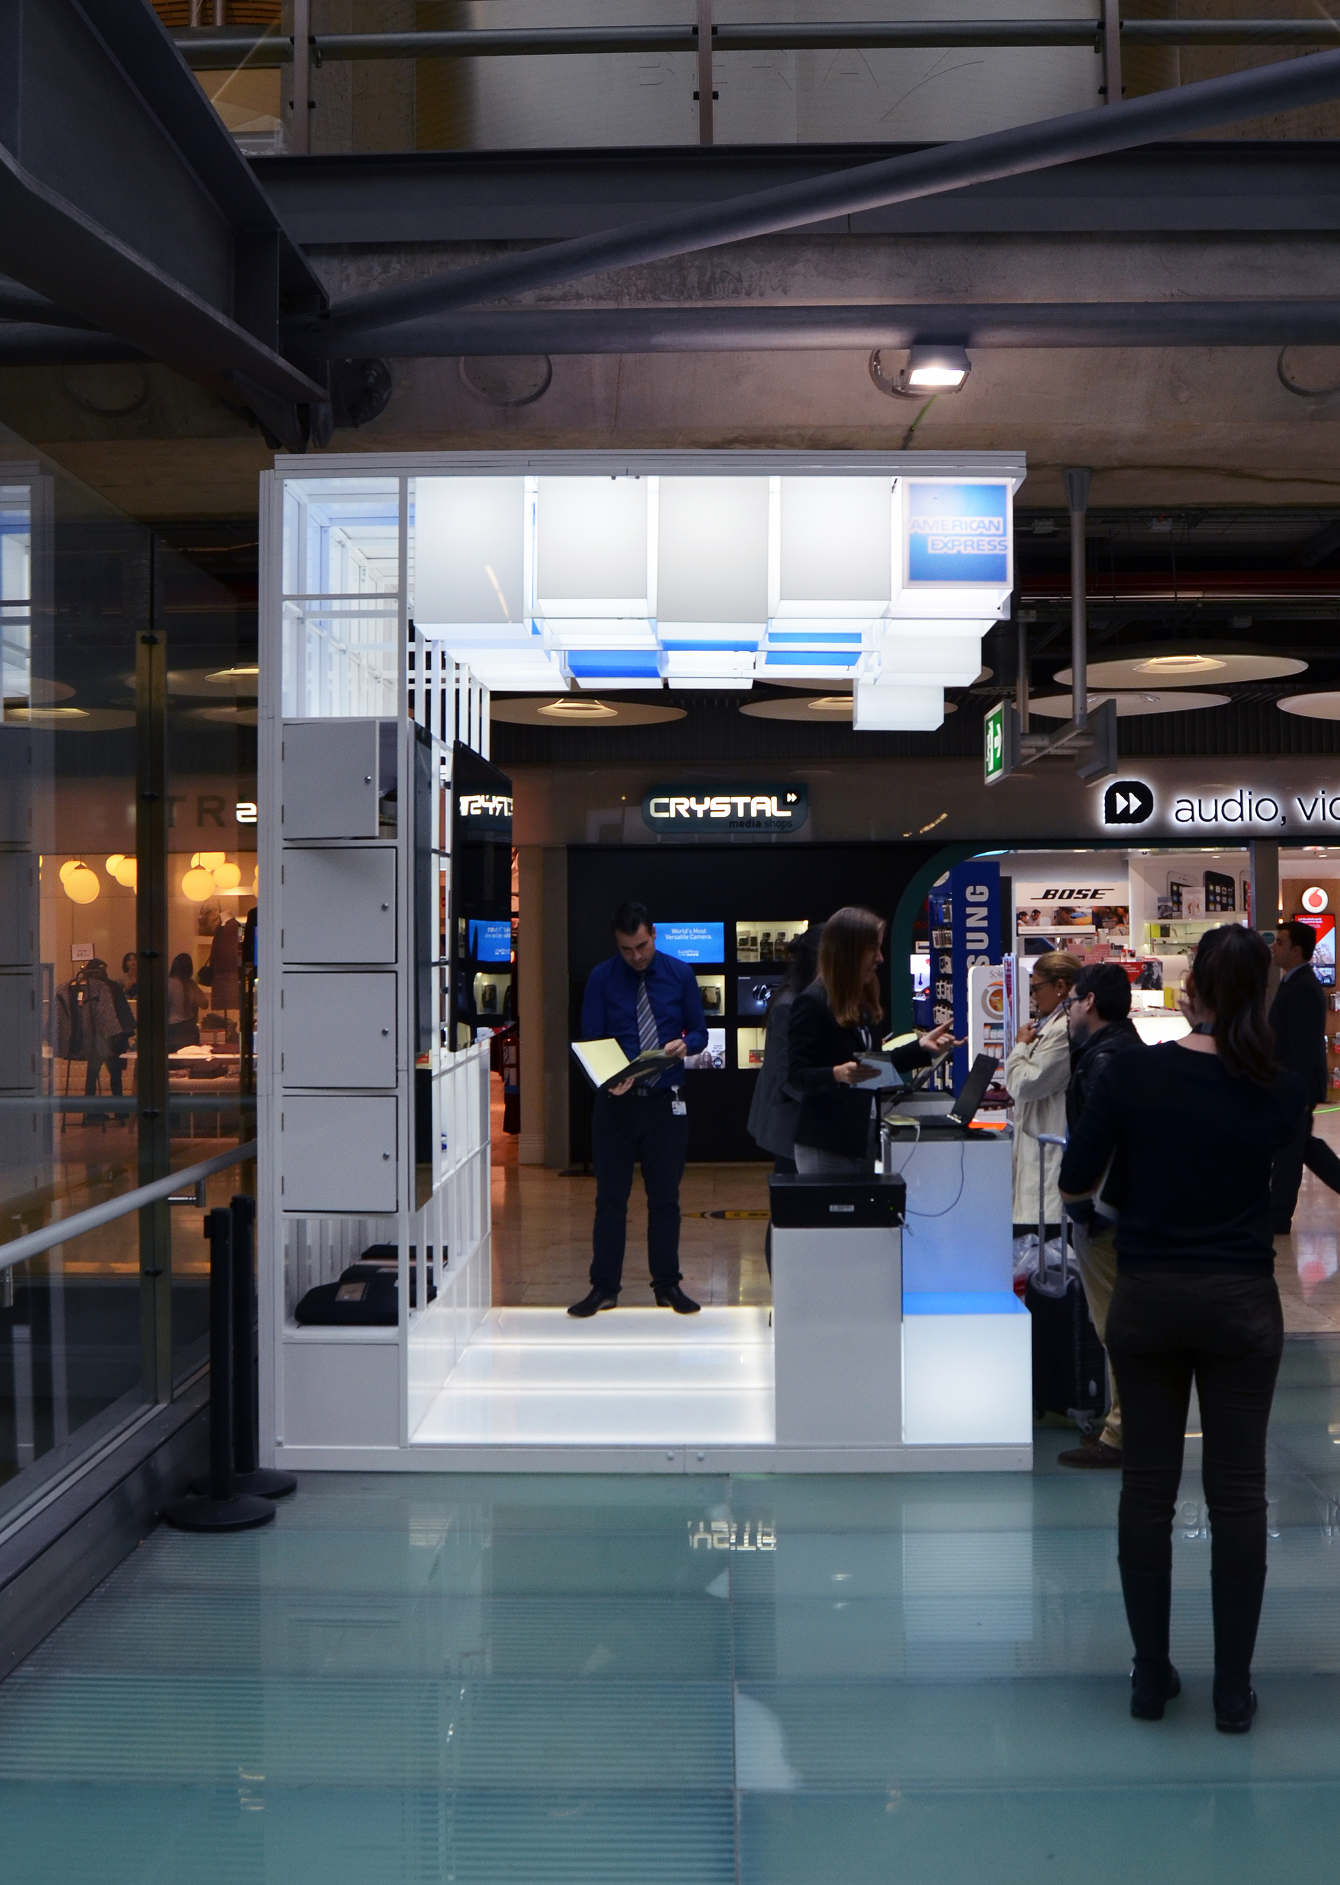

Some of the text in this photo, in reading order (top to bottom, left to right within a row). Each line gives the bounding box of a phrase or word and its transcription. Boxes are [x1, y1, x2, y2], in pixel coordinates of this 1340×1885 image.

[910, 519, 1000, 532] AMERICAN
[930, 538, 1008, 552] EXPRESS
[649, 796, 792, 818] CRYSTAL
[1174, 789, 1287, 825] audio,
[729, 819, 793, 831] media shops
[1030, 888, 1115, 900] BOSE
